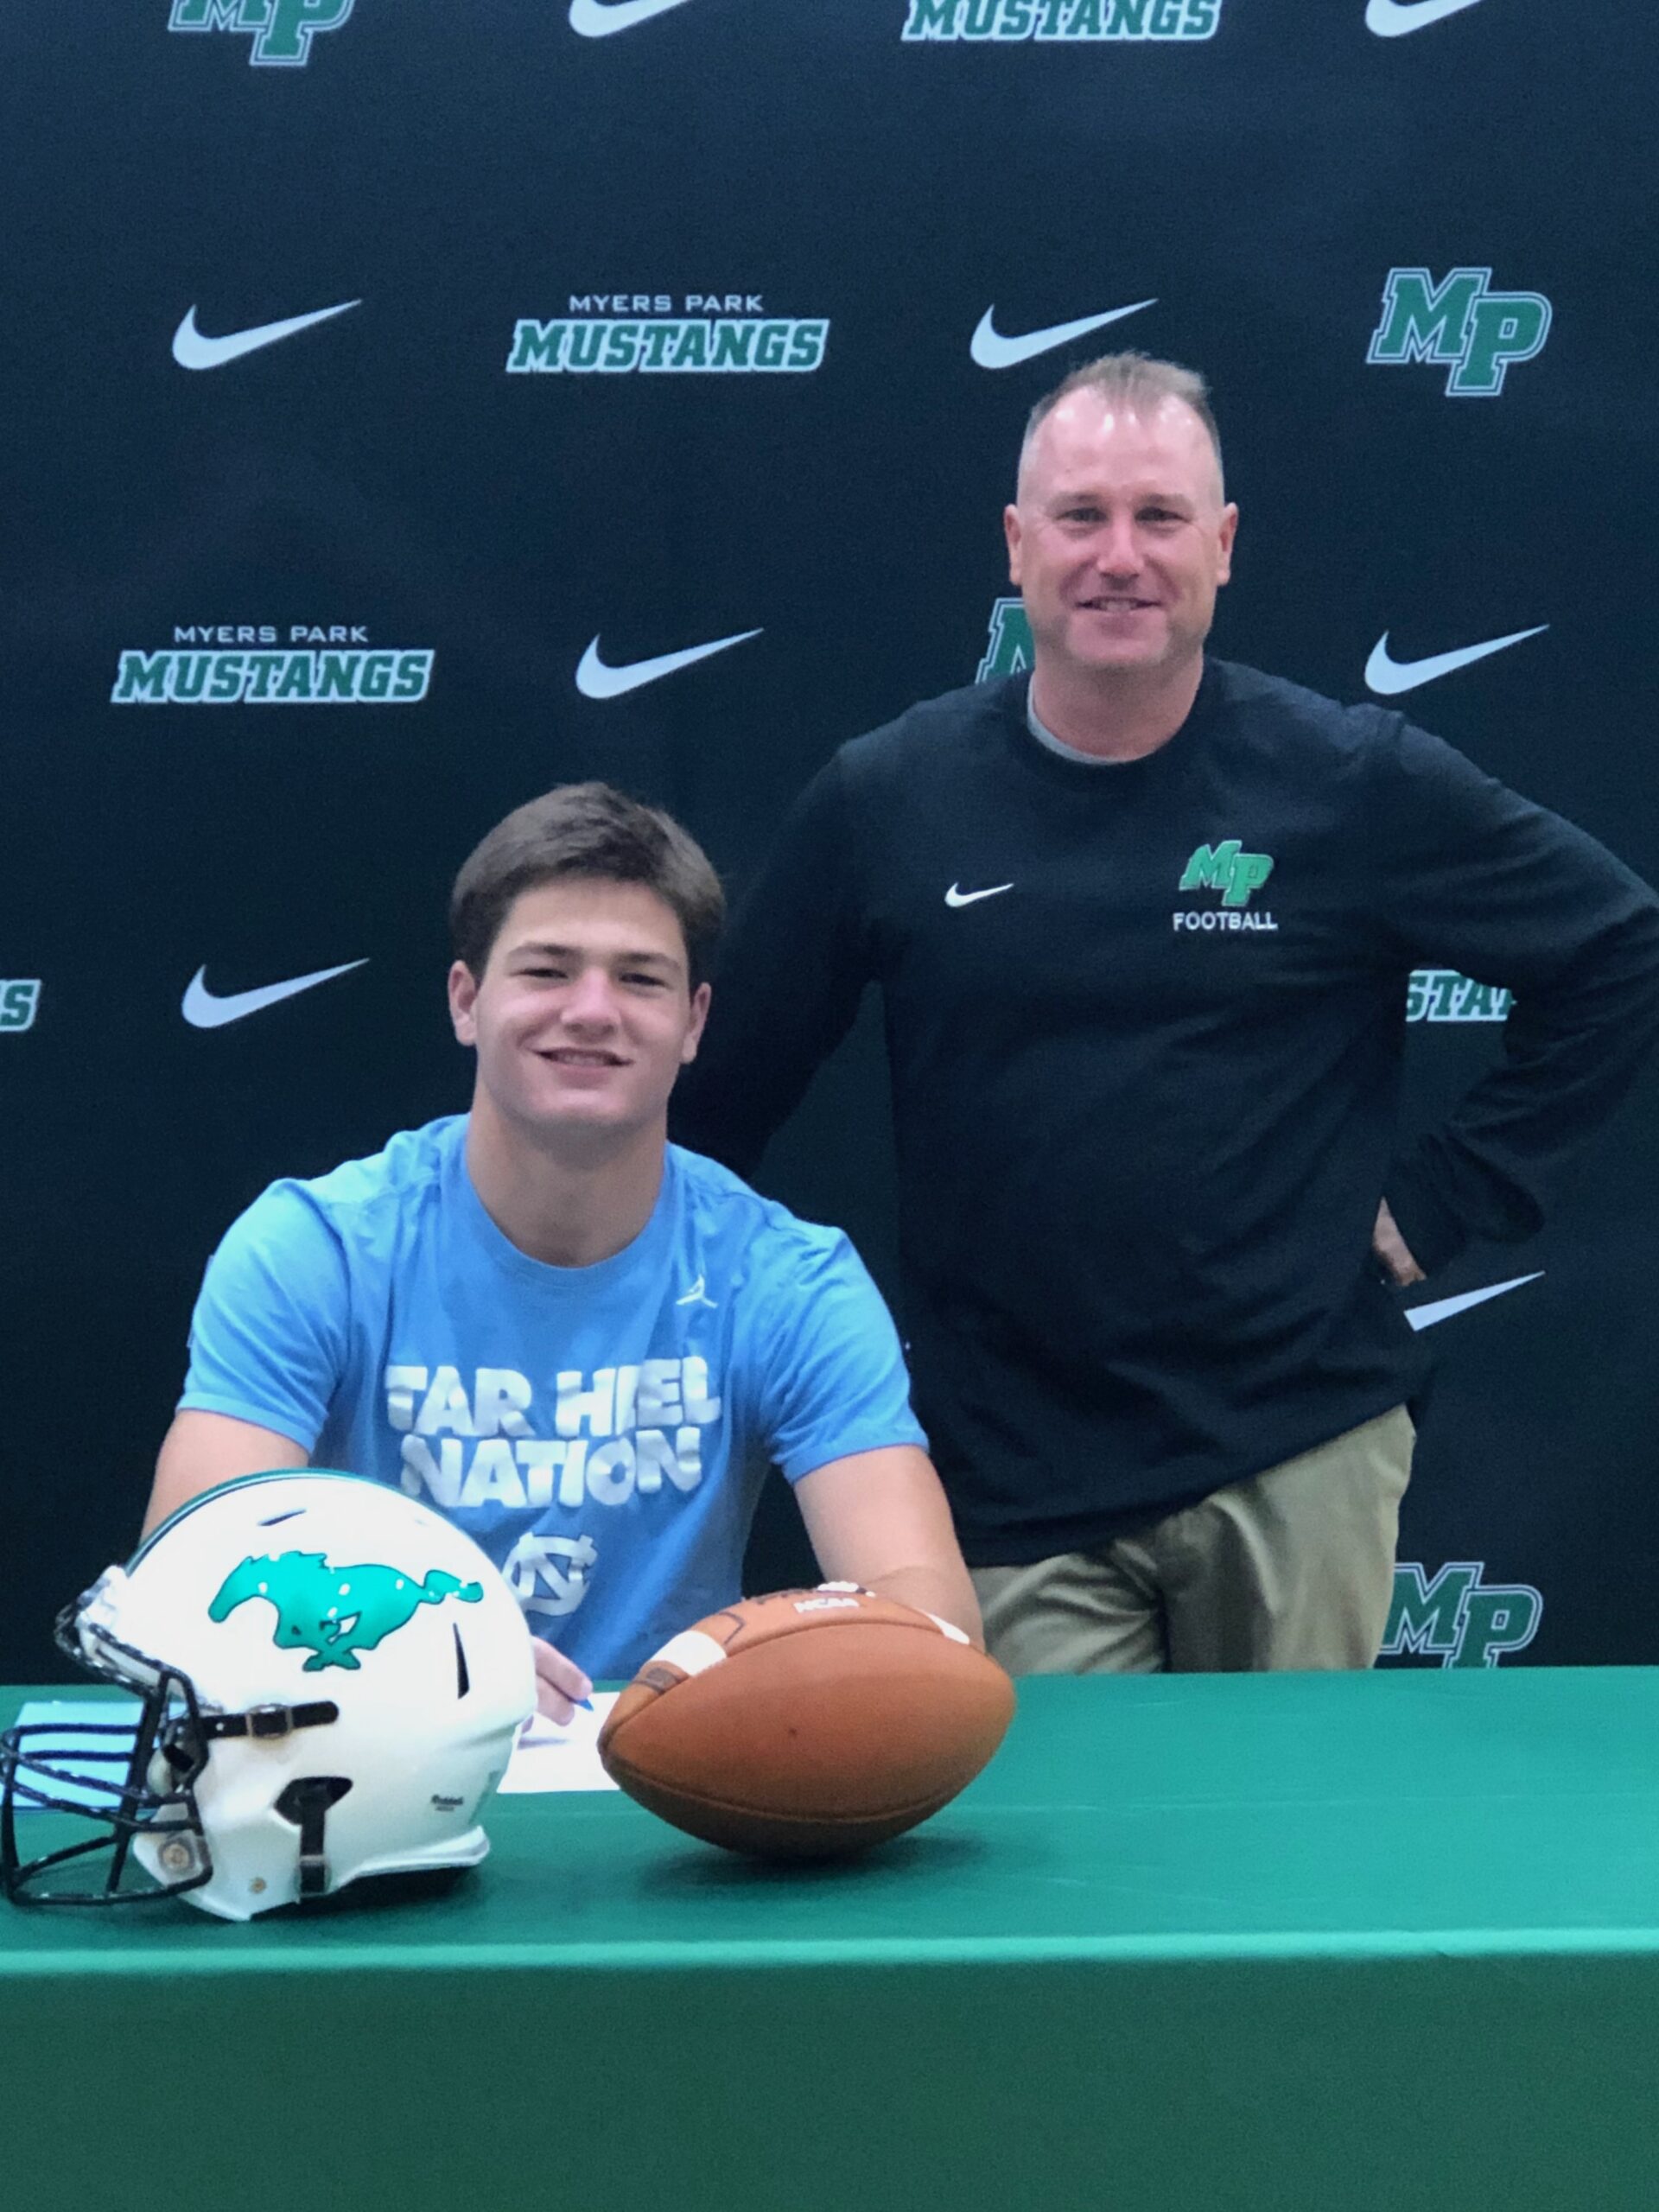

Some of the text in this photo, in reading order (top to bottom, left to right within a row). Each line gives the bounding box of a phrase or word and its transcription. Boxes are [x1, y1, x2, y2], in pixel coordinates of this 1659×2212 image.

[901, 0, 1222, 41] MUSTANGS
[569, 295, 764, 312] MYERS PARK
[506, 319, 830, 372] MUSTANGS
[1366, 267, 1553, 397] MP
[175, 626, 369, 643] MYERS PARK
[111, 650, 435, 703] MUSTANGS
[1179, 840, 1274, 906] MP
[1173, 912, 1278, 931] FOOTBALL
[385, 1365, 536, 1437] TAR
[400, 1426, 702, 1508] NATION
[1377, 1561, 1543, 1669] MP
